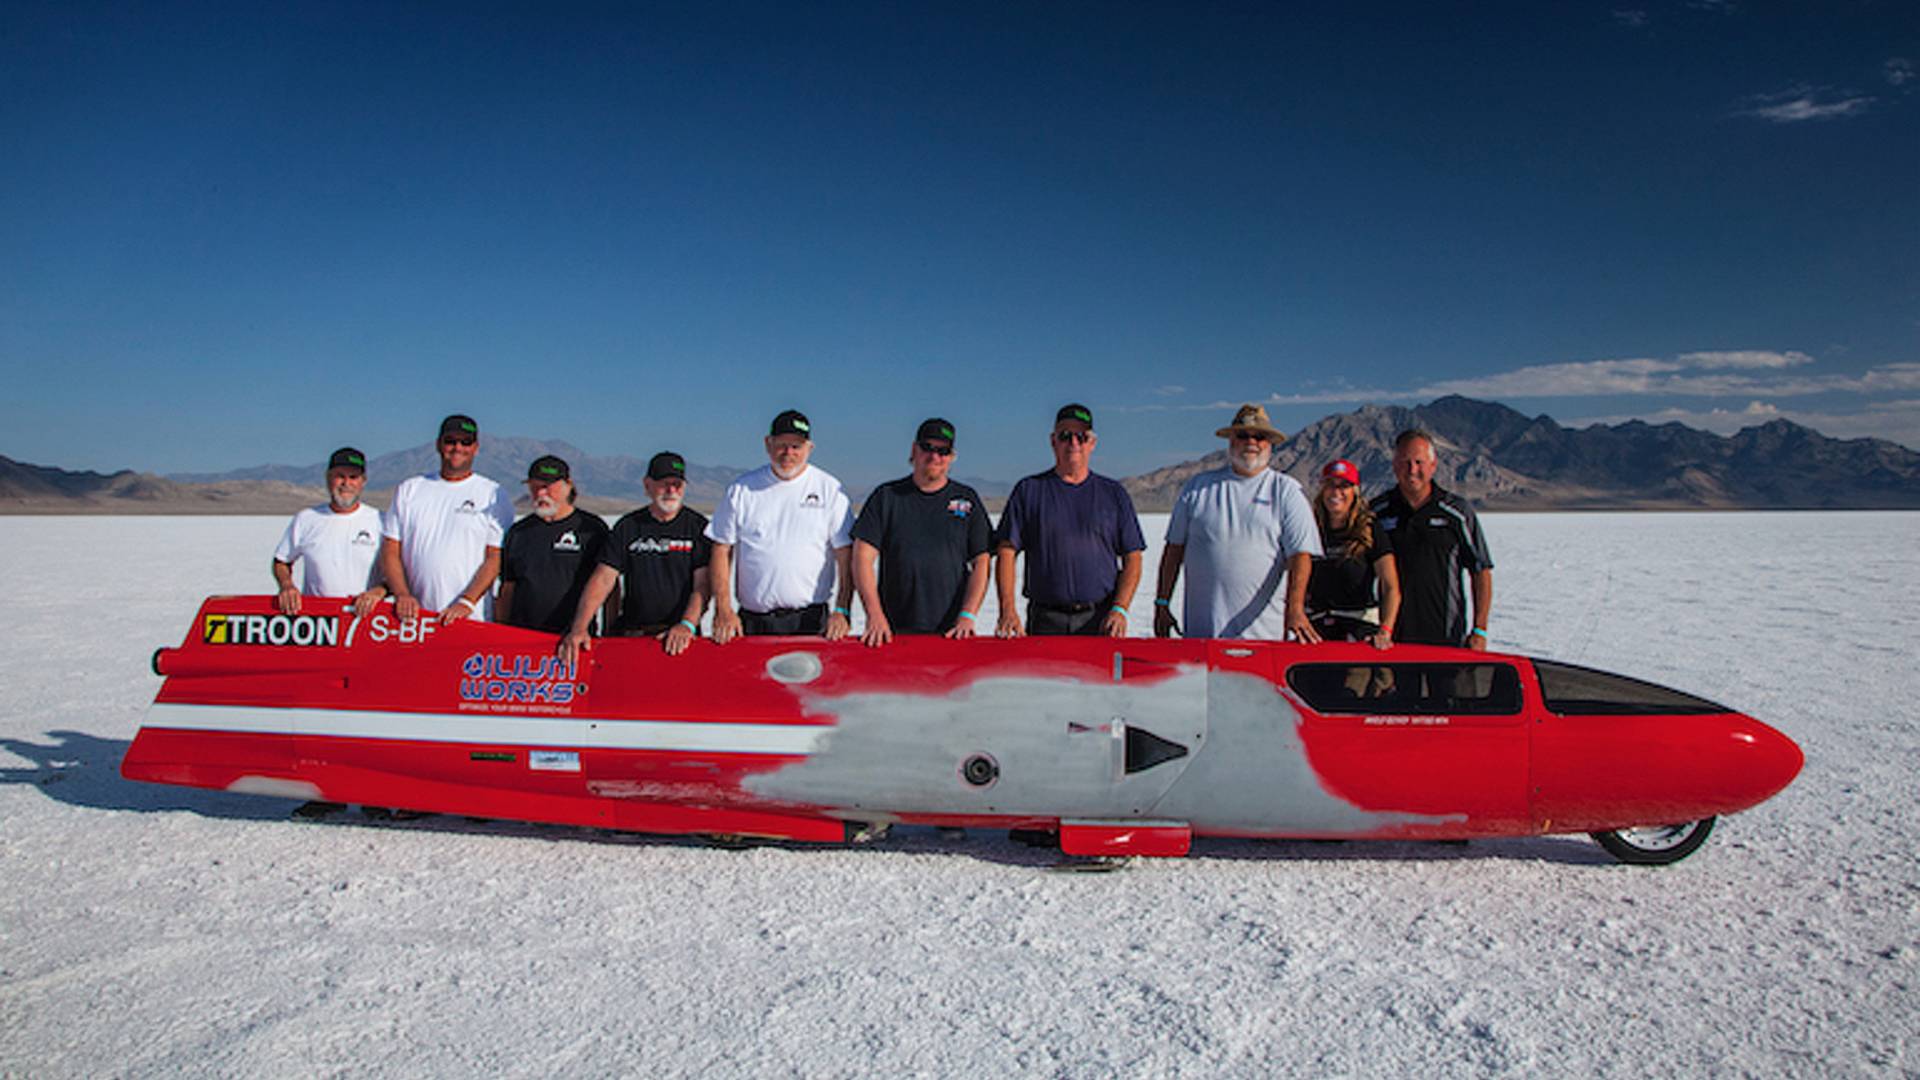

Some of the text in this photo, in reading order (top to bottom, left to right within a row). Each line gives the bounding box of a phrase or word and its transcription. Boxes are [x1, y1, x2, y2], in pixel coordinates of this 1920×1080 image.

[227, 615, 338, 646] TROON
[369, 614, 436, 643] S-BF
[461, 679, 574, 703] WORKS
